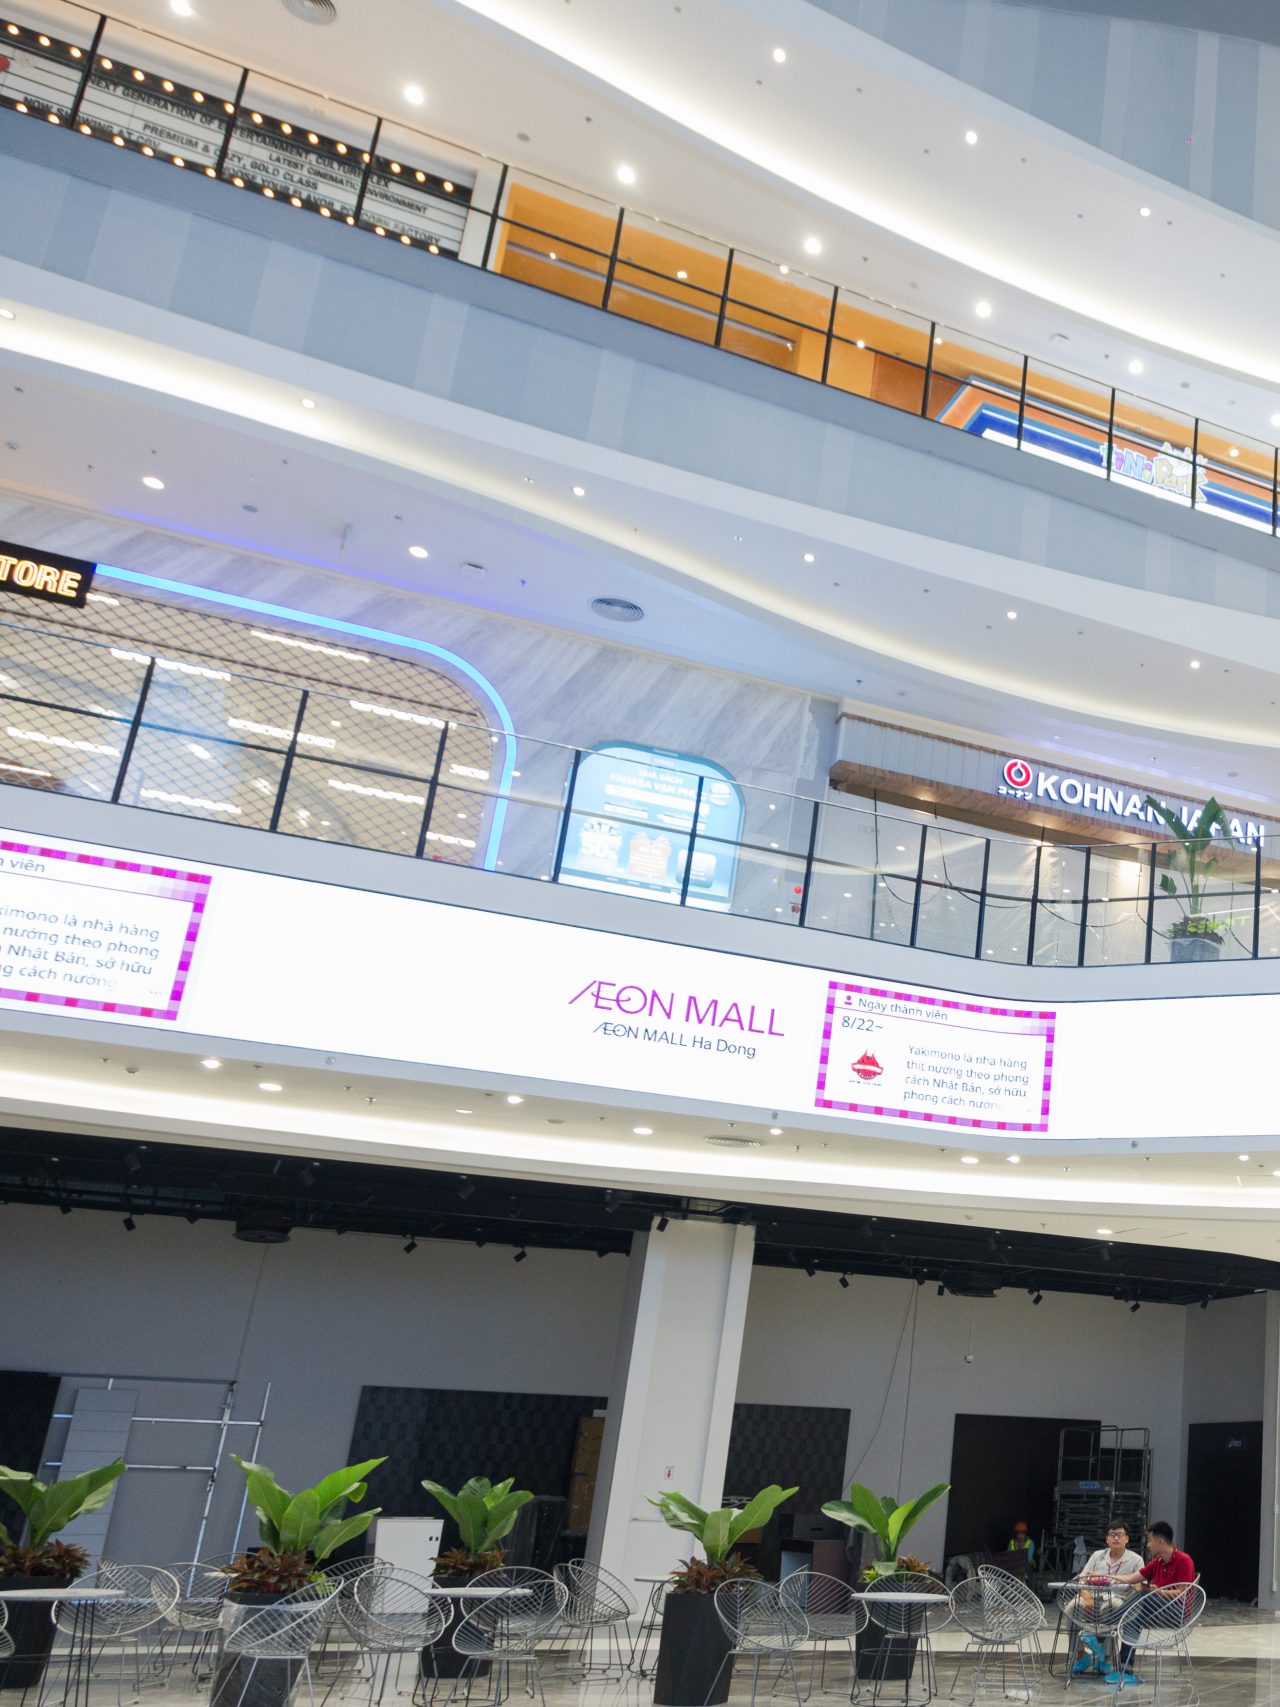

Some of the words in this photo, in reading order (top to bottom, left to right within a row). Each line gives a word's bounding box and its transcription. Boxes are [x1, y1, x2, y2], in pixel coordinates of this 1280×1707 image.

[122, 85, 197, 121] GENERATION
[142, 122, 198, 149] PREMIUM
[250, 160, 281, 178] GOLD
[282, 171, 319, 191] CLASS
[268, 152, 304, 172] LATEST
[365, 186, 429, 215] NVIRONMENT
[1036, 772, 1167, 826] KOHNAN
[10, 858, 46, 873] viên
[65, 934, 103, 949] theo
[106, 941, 161, 961] phong
[19, 965, 57, 980] cách
[684, 994, 786, 1037] MALL
[857, 997, 888, 1014] Ngày
[889, 1002, 923, 1017] thành
[925, 1008, 949, 1022] viên
[642, 1027, 688, 1047] MALL
[692, 1034, 713, 1051] Ha
[715, 1038, 757, 1060] Dong
[908, 1044, 961, 1062] Yakimono
[965, 1069, 991, 1080] theo
[993, 1071, 1030, 1086] phong
[903, 1089, 939, 1106] phong
[941, 1095, 966, 1107] cách
